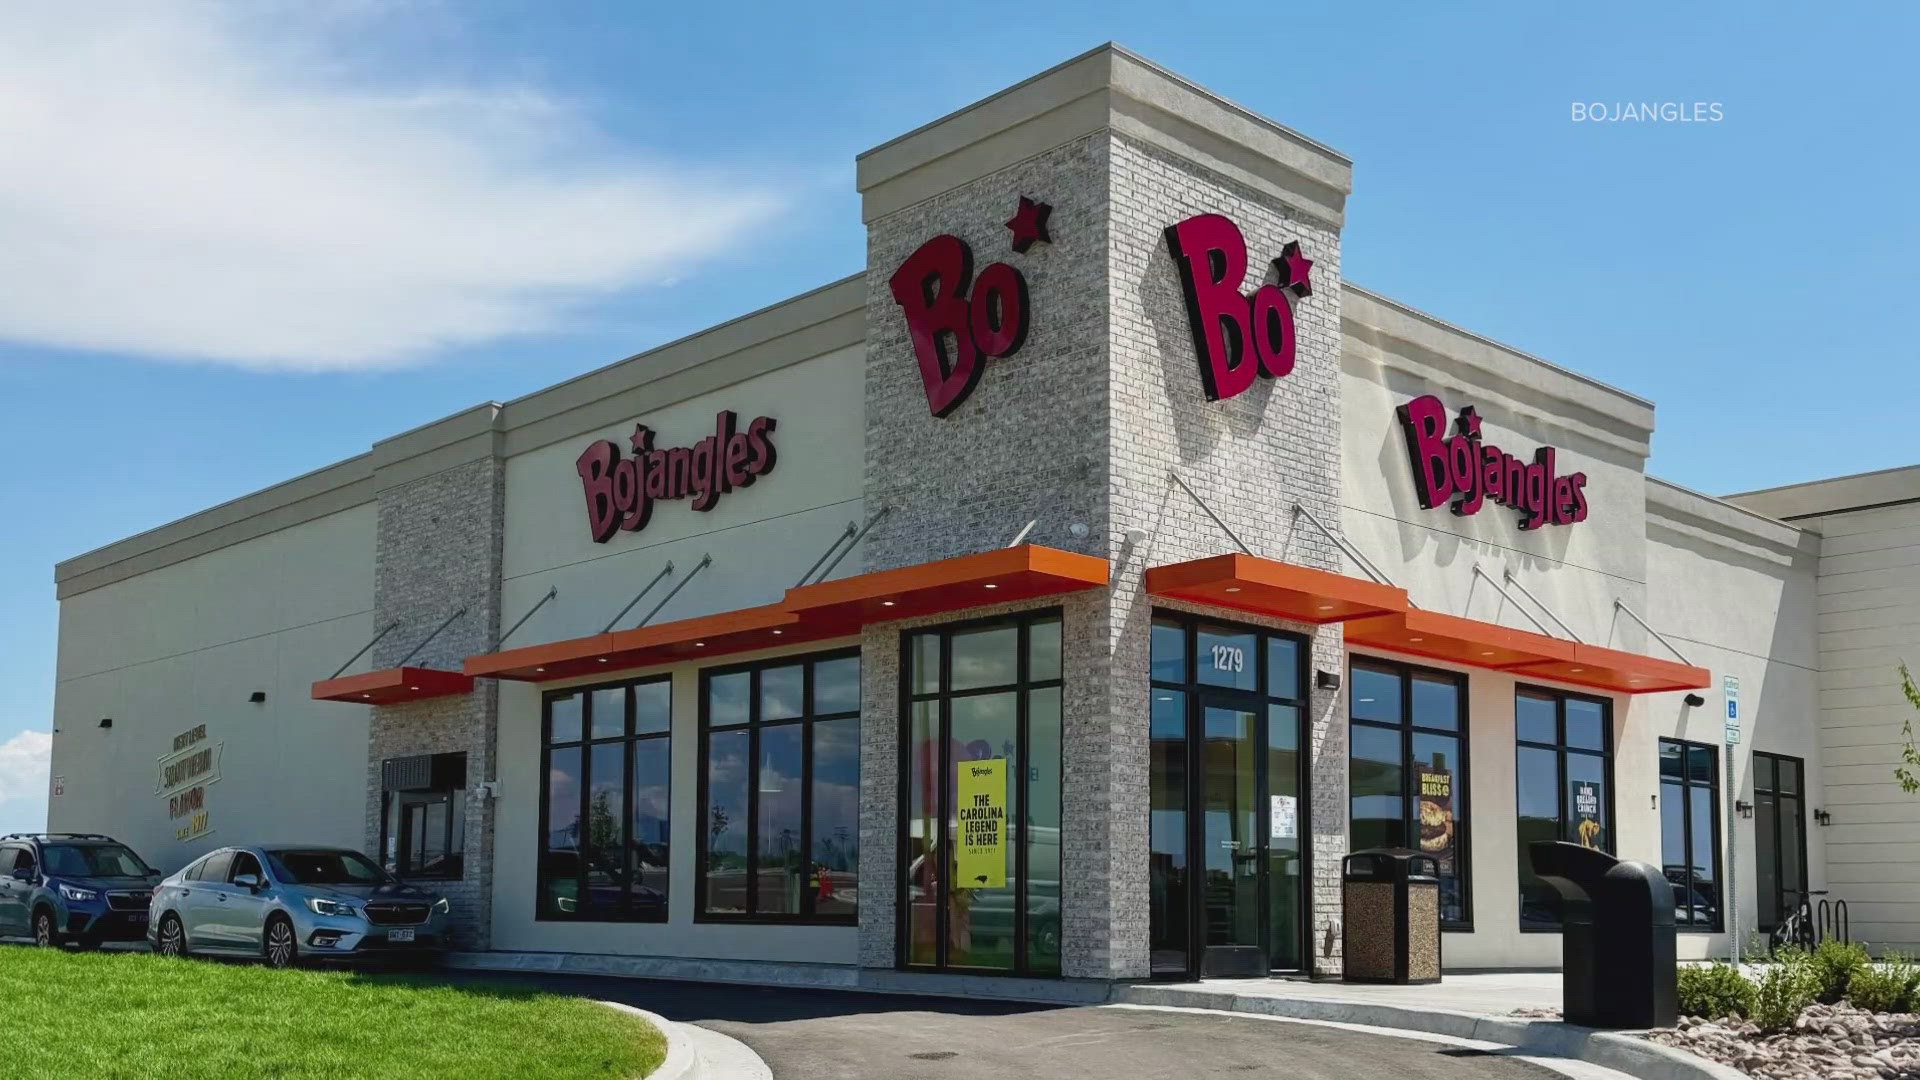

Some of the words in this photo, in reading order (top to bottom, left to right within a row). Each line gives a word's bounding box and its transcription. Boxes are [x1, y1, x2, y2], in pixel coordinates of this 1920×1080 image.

[1164, 213, 1296, 402] Bo
[889, 233, 1030, 419] Bo
[1396, 394, 1588, 531] Bojangles
[576, 410, 777, 544] Bojangles
[1211, 645, 1243, 672] 1279
[971, 767, 992, 777] Bojangles
[1421, 773, 1450, 784] BREAKFAST
[1422, 783, 1441, 796] BLISS
[974, 795, 989, 806] THE
[960, 807, 1003, 820] CAROLINA
[1577, 804, 1597, 813] CRUNCH
[965, 820, 998, 833] LEGEND
[965, 833, 974, 846] IS
[976, 833, 998, 846] HERE
